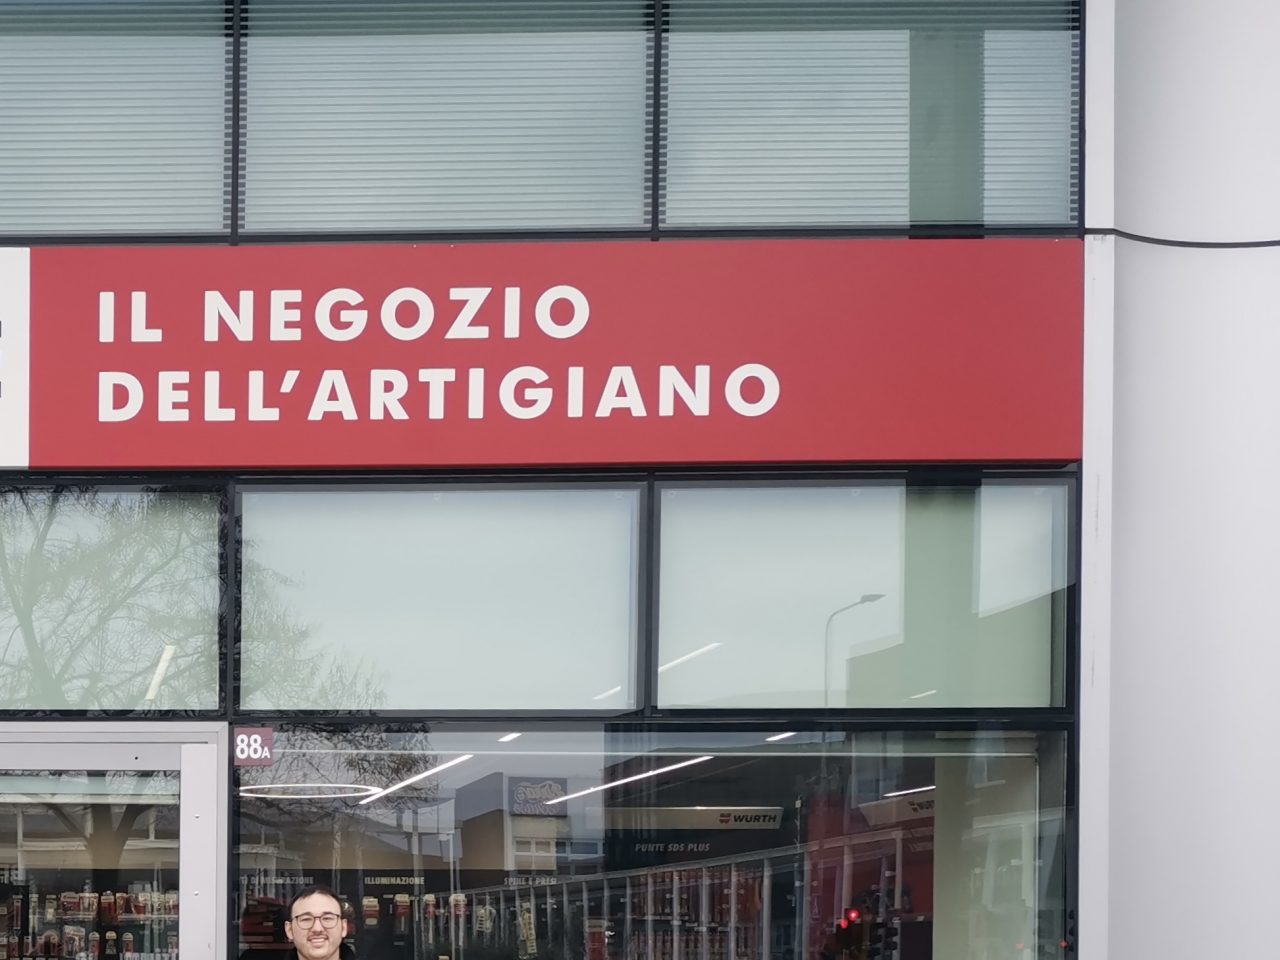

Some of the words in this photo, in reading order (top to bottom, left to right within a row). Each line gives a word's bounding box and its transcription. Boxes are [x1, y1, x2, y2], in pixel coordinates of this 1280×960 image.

[98, 290, 163, 343] IL
[204, 285, 591, 343] NEGOZIO
[98, 363, 781, 424] DELL’ARTIGIANO
[688, 843, 710, 852] PLUS
